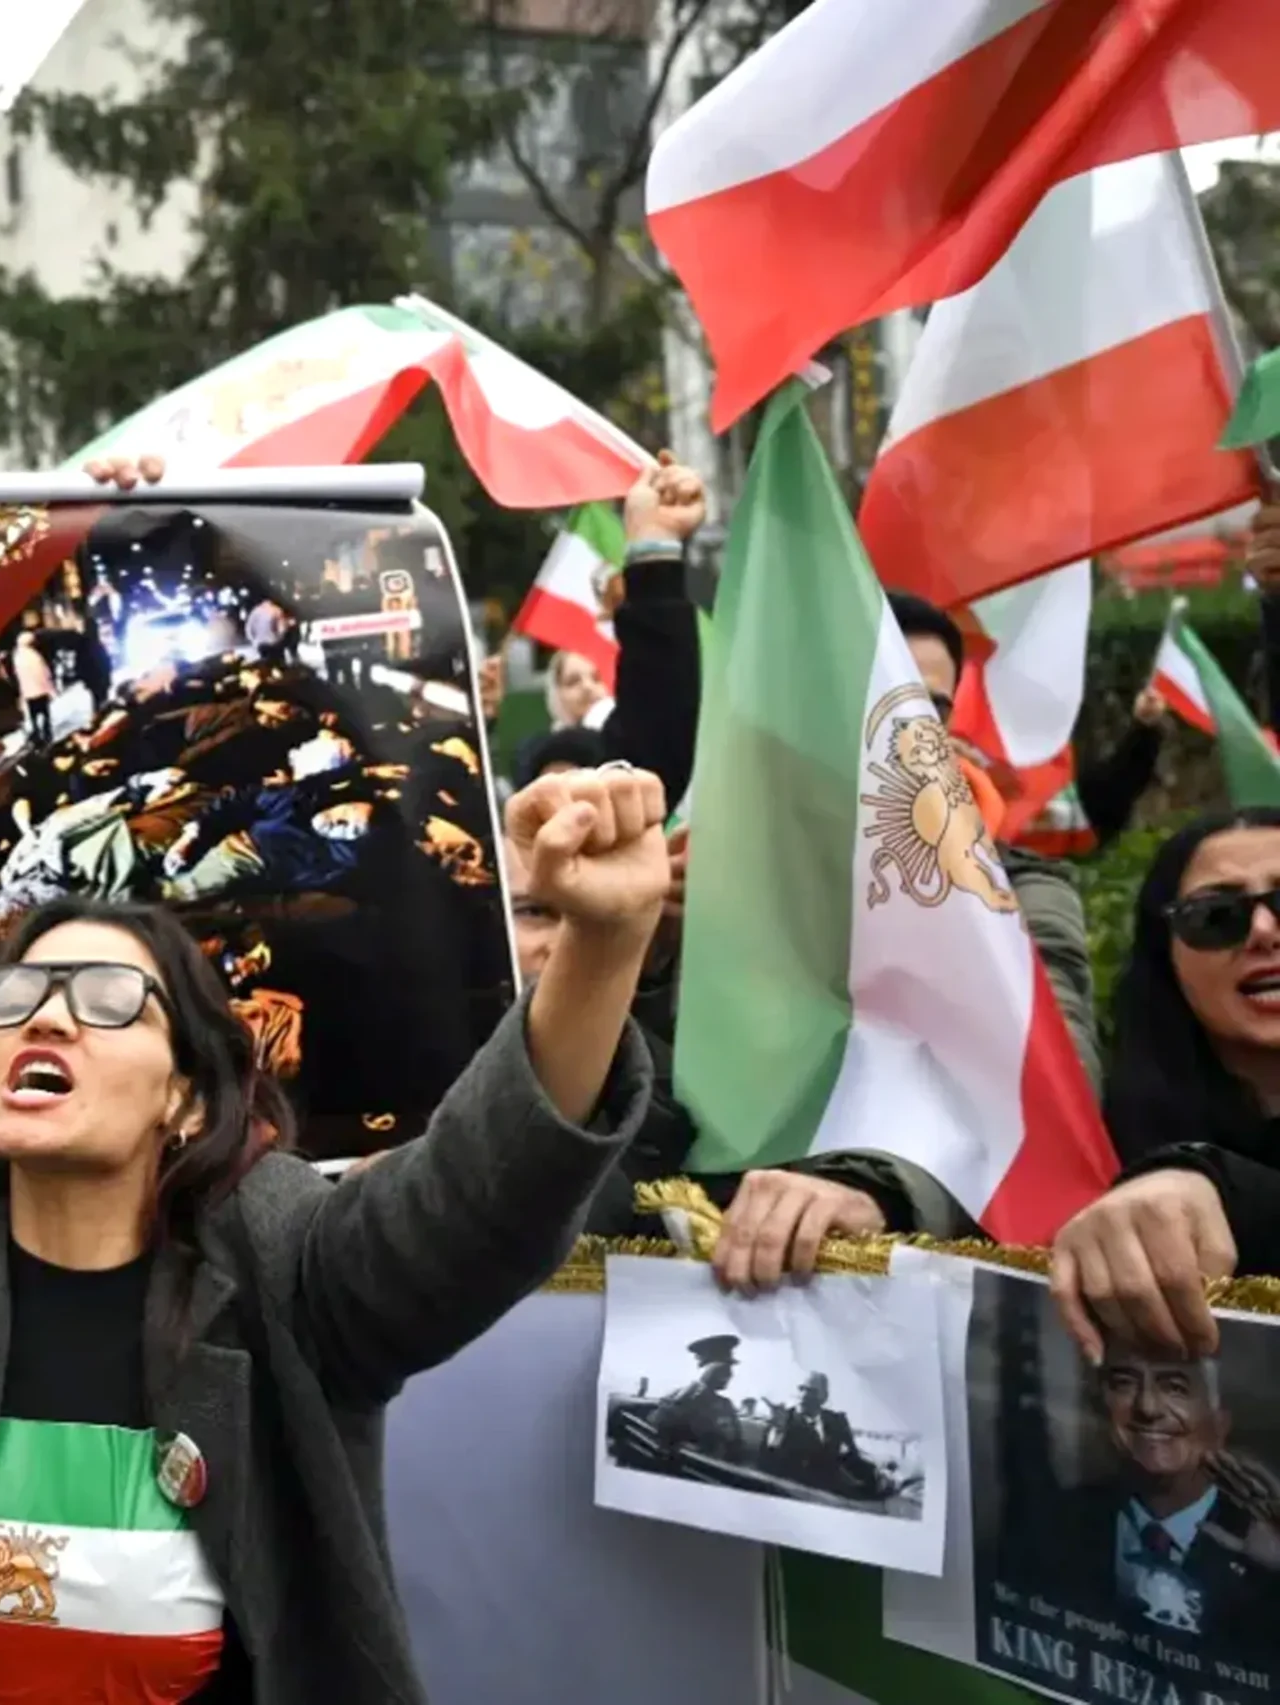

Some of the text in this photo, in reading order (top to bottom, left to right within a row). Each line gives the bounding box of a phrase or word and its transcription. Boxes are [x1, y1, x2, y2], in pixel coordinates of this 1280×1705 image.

[989, 1615, 1078, 1681] KING
[1064, 1609, 1130, 1643] people
[1155, 1639, 1202, 1672] Iran
[1214, 1659, 1271, 1691] want
